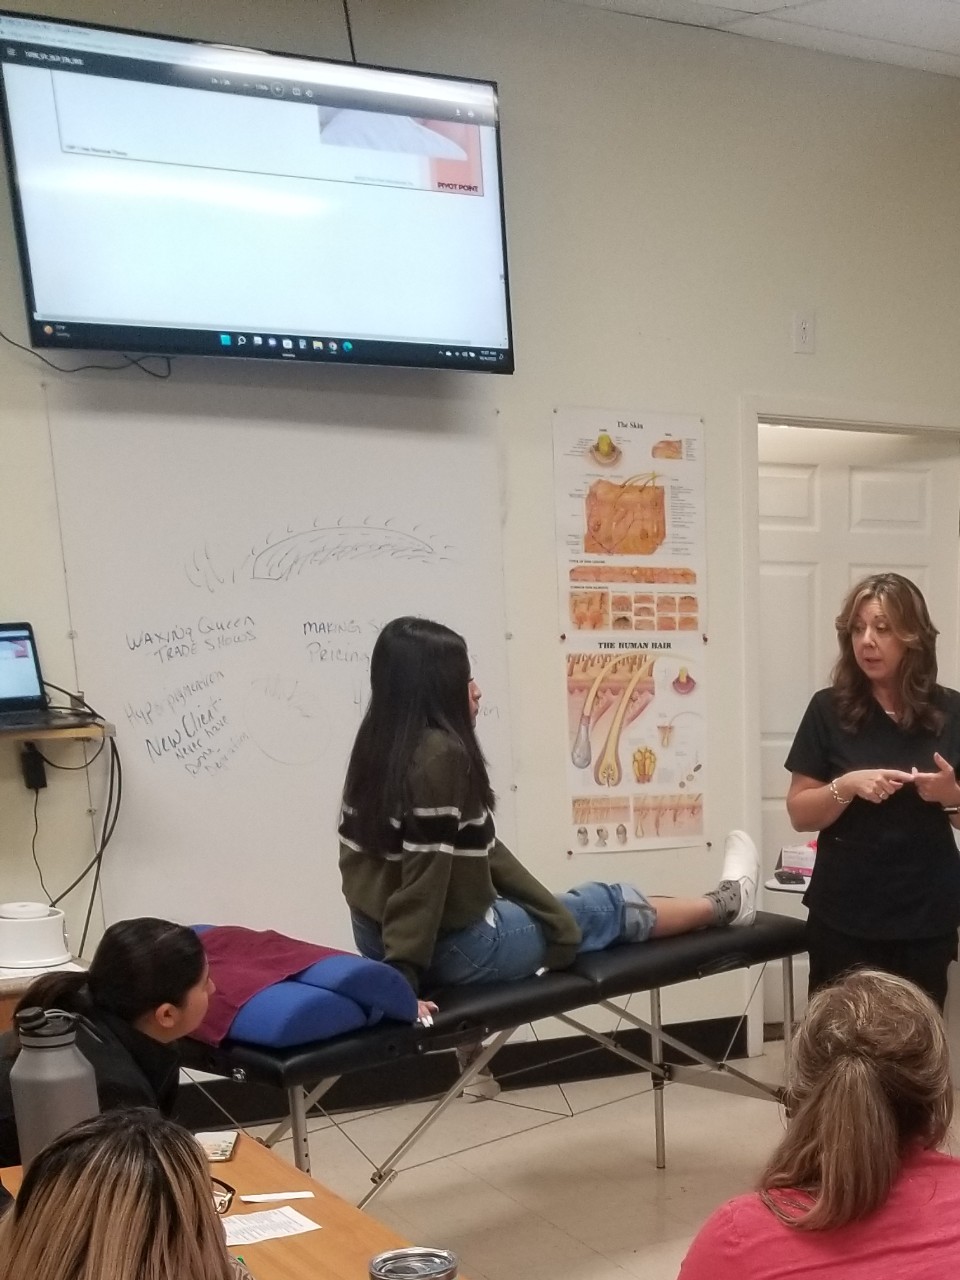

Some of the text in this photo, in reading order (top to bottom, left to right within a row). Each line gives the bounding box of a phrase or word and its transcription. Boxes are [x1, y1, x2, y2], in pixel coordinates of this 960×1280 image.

[437, 181, 478, 192] PIVOT POINT
[617, 420, 644, 430] The Skin
[598, 641, 672, 650] THE HUMAN HAIR
[154, 642, 198, 663] TRADE
